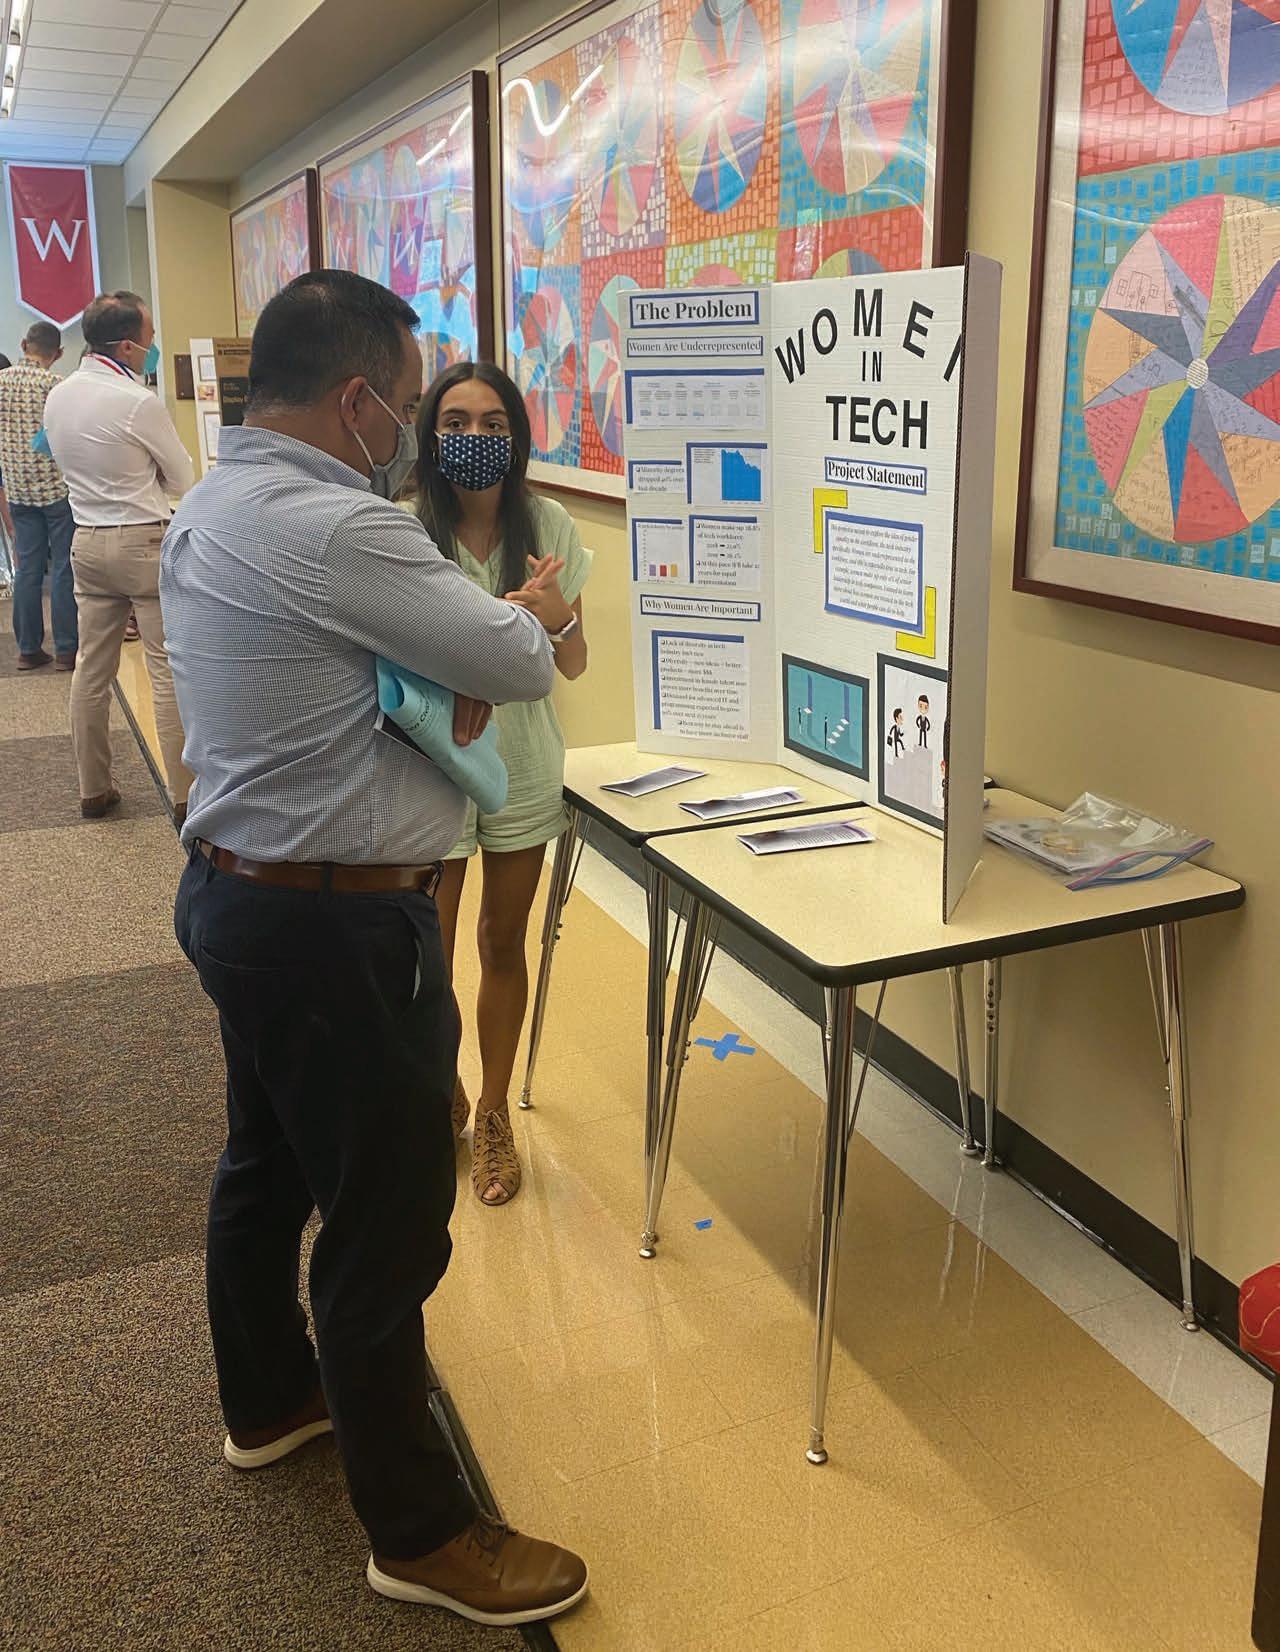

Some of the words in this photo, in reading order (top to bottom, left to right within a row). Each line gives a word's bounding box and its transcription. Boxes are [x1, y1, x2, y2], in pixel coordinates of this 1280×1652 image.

[20, 217, 88, 263] W
[636, 302, 670, 320] The
[675, 300, 752, 319] Problem
[629, 342, 660, 352] Women
[663, 342, 678, 352] Are
[680, 340, 761, 353] Underrepresented
[861, 350, 882, 382] IN
[825, 395, 928, 449] TECH
[828, 461, 865, 481] Project
[866, 466, 924, 488] Statement
[645, 600, 662, 610] Why
[663, 601, 694, 611] Women
[696, 603, 708, 612] Are
[711, 604, 752, 615] Important
